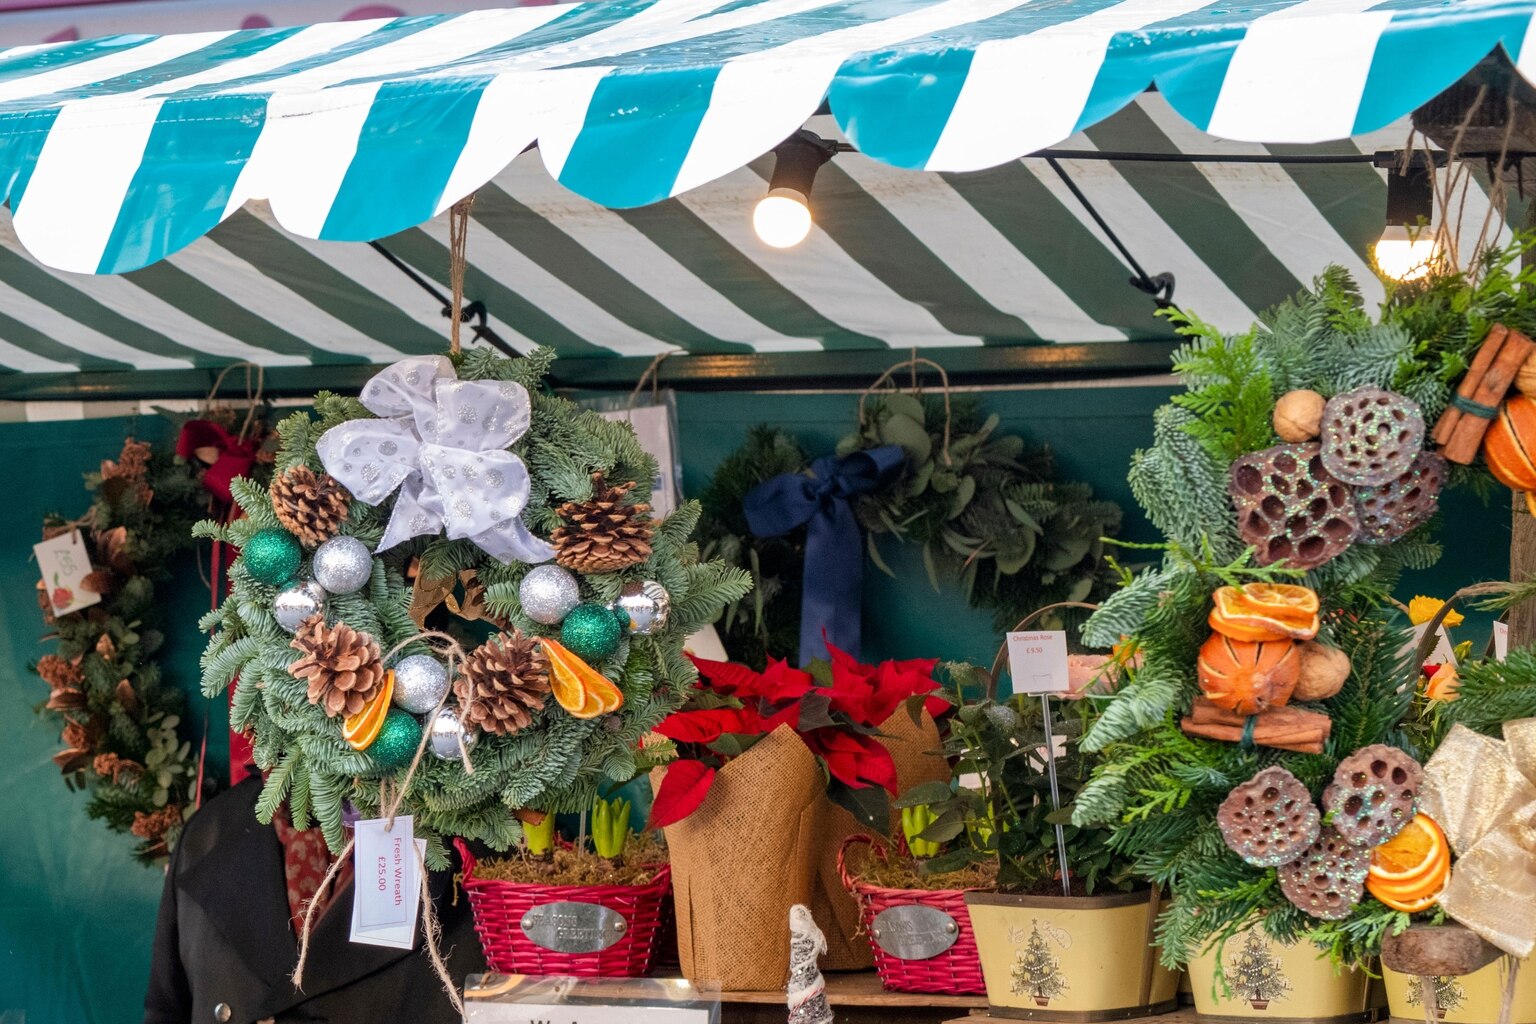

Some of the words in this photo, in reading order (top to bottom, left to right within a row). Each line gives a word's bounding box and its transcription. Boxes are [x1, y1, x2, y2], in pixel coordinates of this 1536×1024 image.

[394, 837, 402, 862] Fresh
[378, 856, 386, 891] £25.00
[394, 867, 403, 906] Wreath
